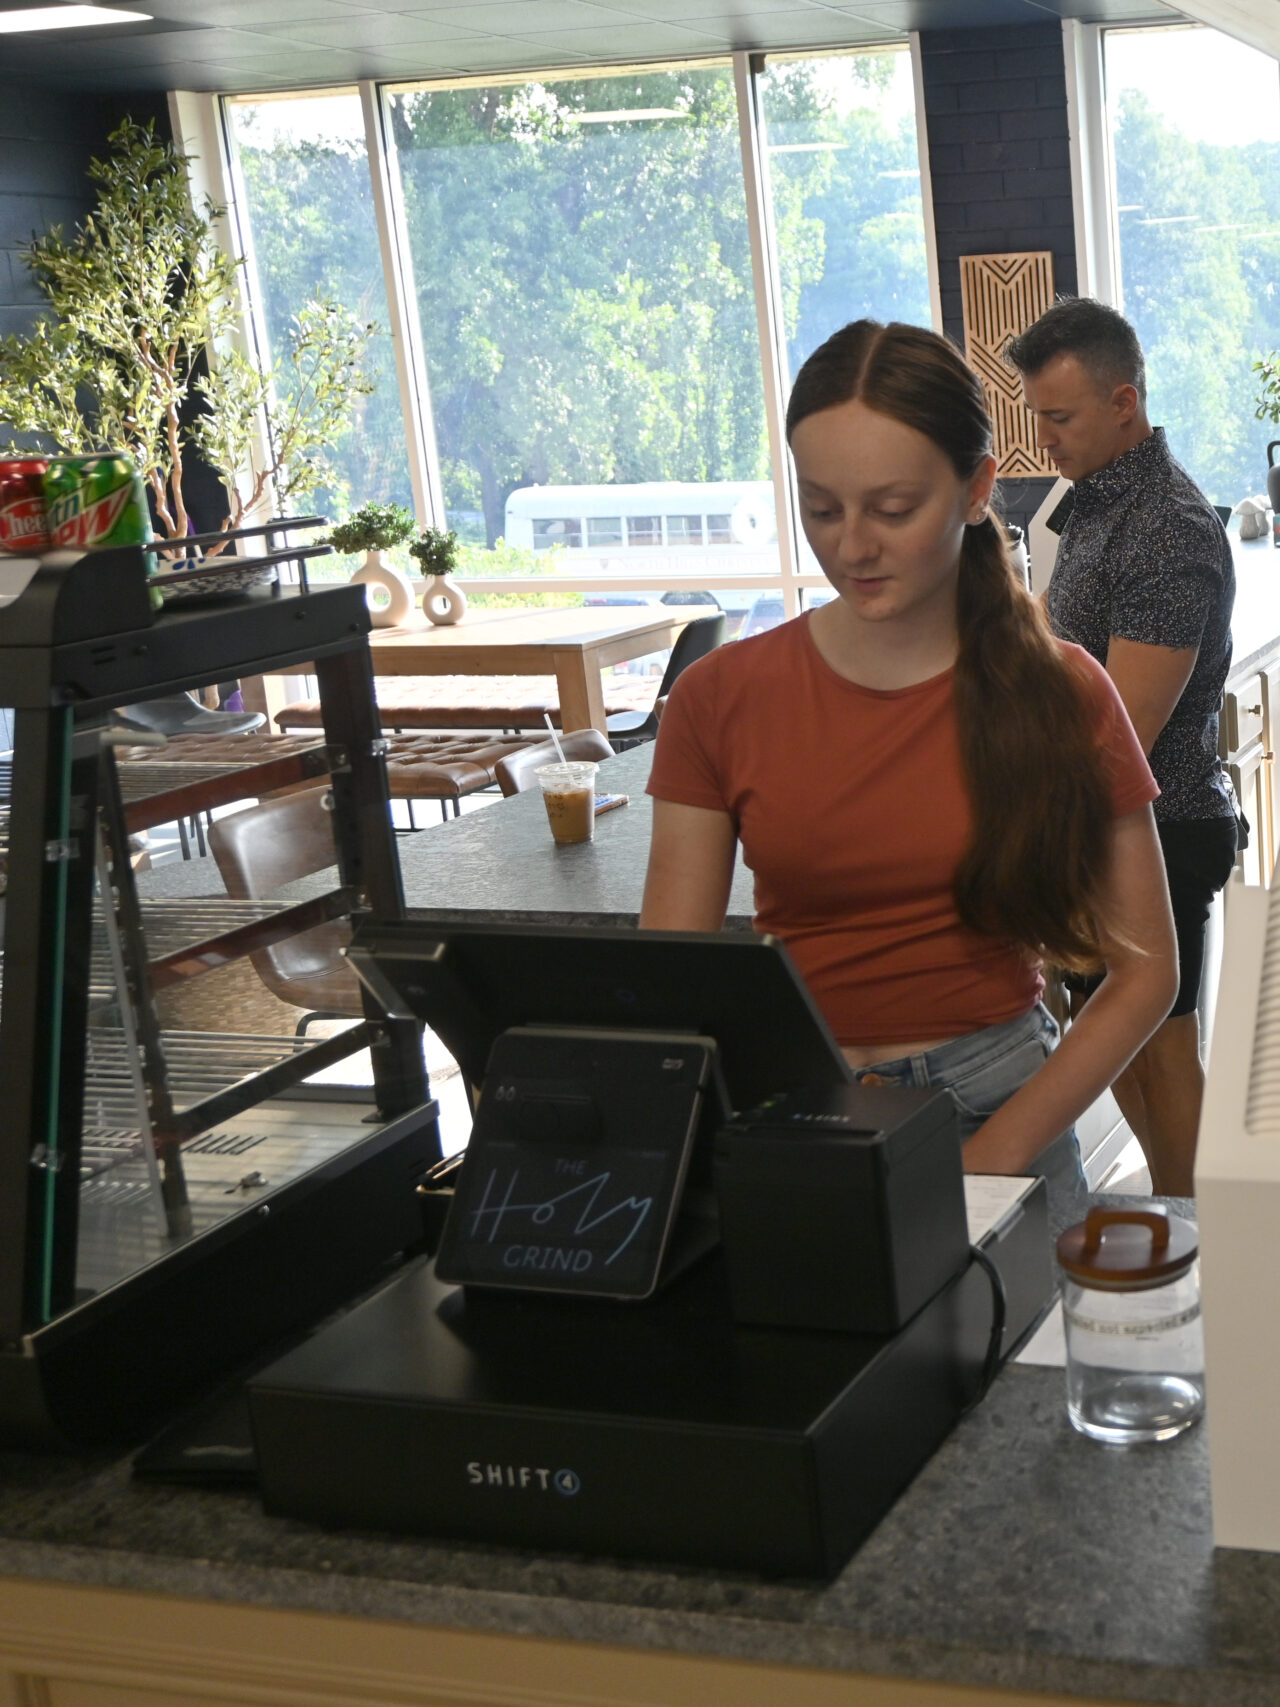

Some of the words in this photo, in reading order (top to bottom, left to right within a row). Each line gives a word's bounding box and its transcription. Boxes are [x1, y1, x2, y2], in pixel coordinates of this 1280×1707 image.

[554, 1159, 586, 1175] THE
[470, 1168, 653, 1265] Holy
[503, 1244, 592, 1272] GRIND
